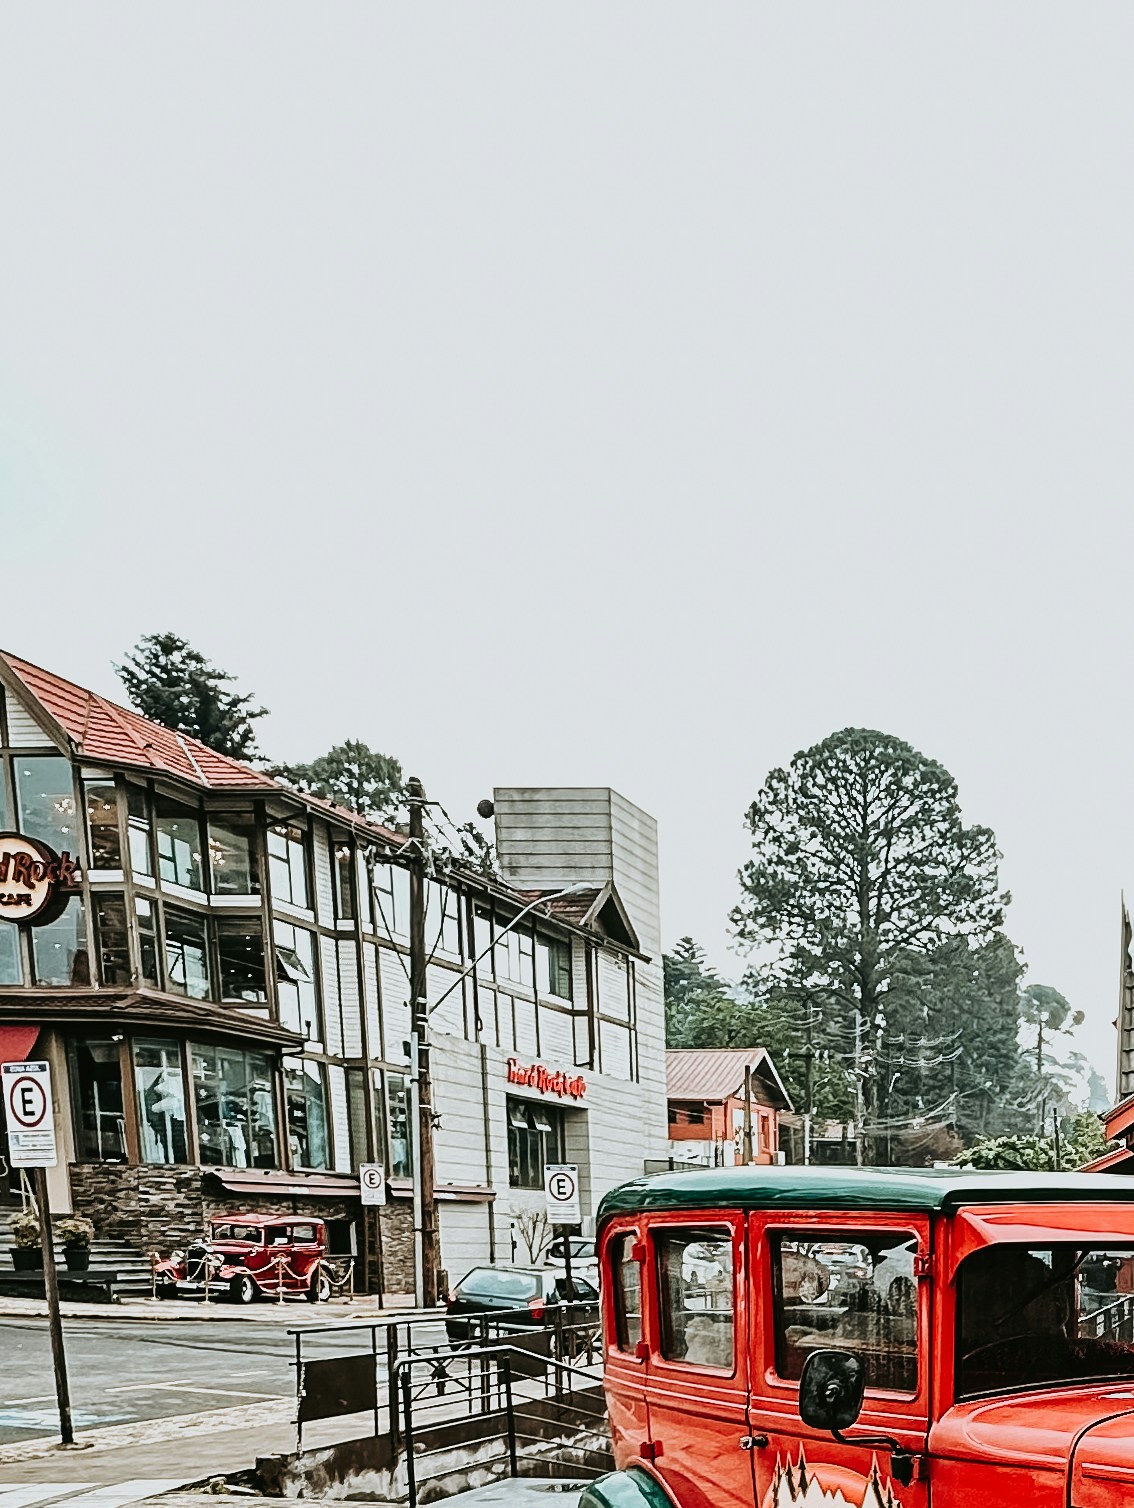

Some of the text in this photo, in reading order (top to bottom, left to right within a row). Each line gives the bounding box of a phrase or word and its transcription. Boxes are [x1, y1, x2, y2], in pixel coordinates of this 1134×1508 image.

[20, 1087, 36, 1116] E
[369, 1173, 376, 1185] E
[557, 1178, 567, 1196] E
